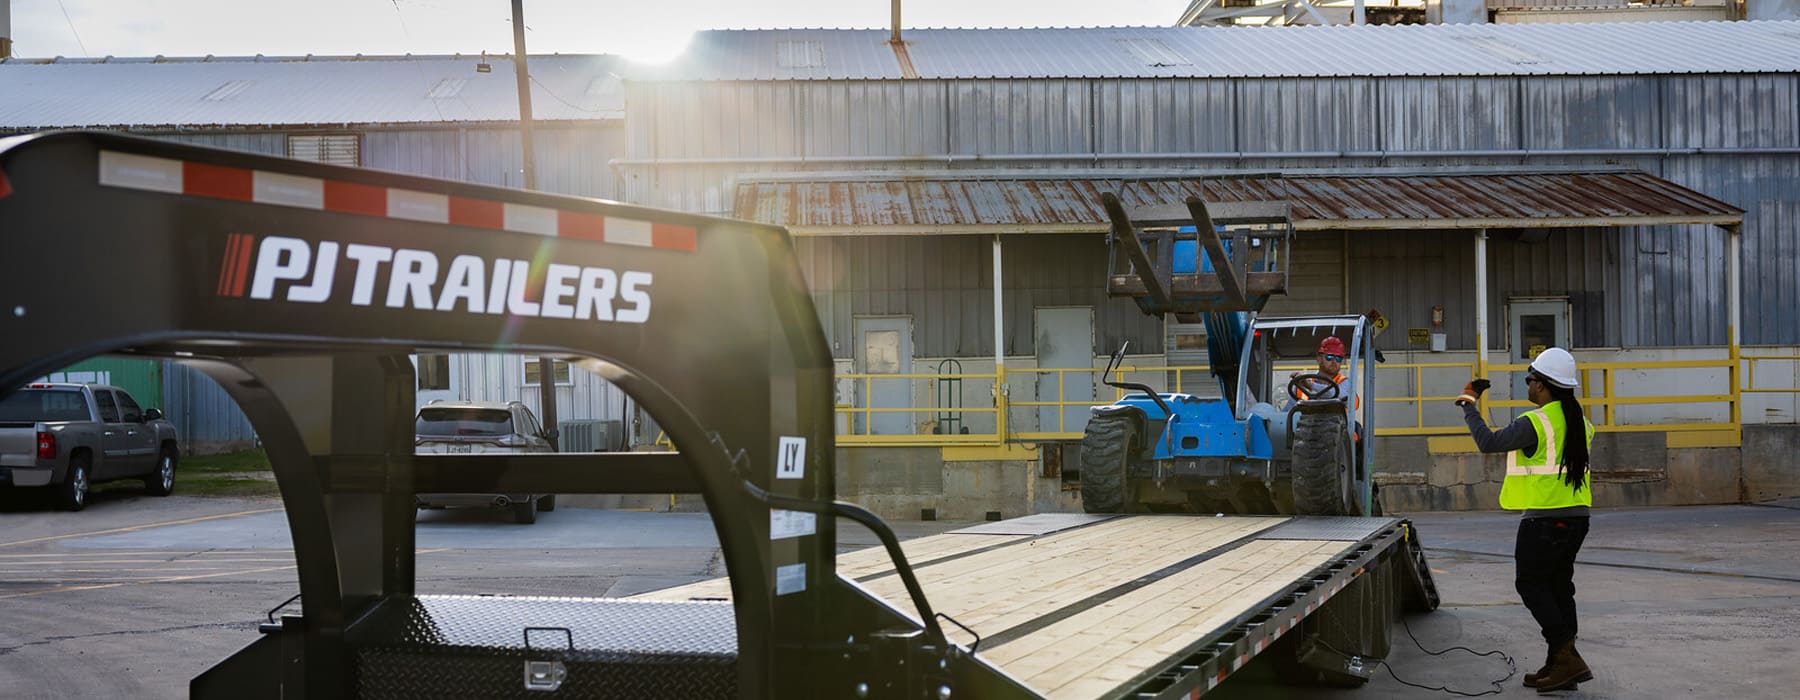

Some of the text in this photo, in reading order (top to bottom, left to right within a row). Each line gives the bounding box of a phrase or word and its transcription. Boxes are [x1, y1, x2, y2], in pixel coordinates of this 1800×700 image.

[250, 236, 653, 323] PJ TRAILERS
[1377, 318, 1385, 329] 3
[784, 443, 799, 472] LY
